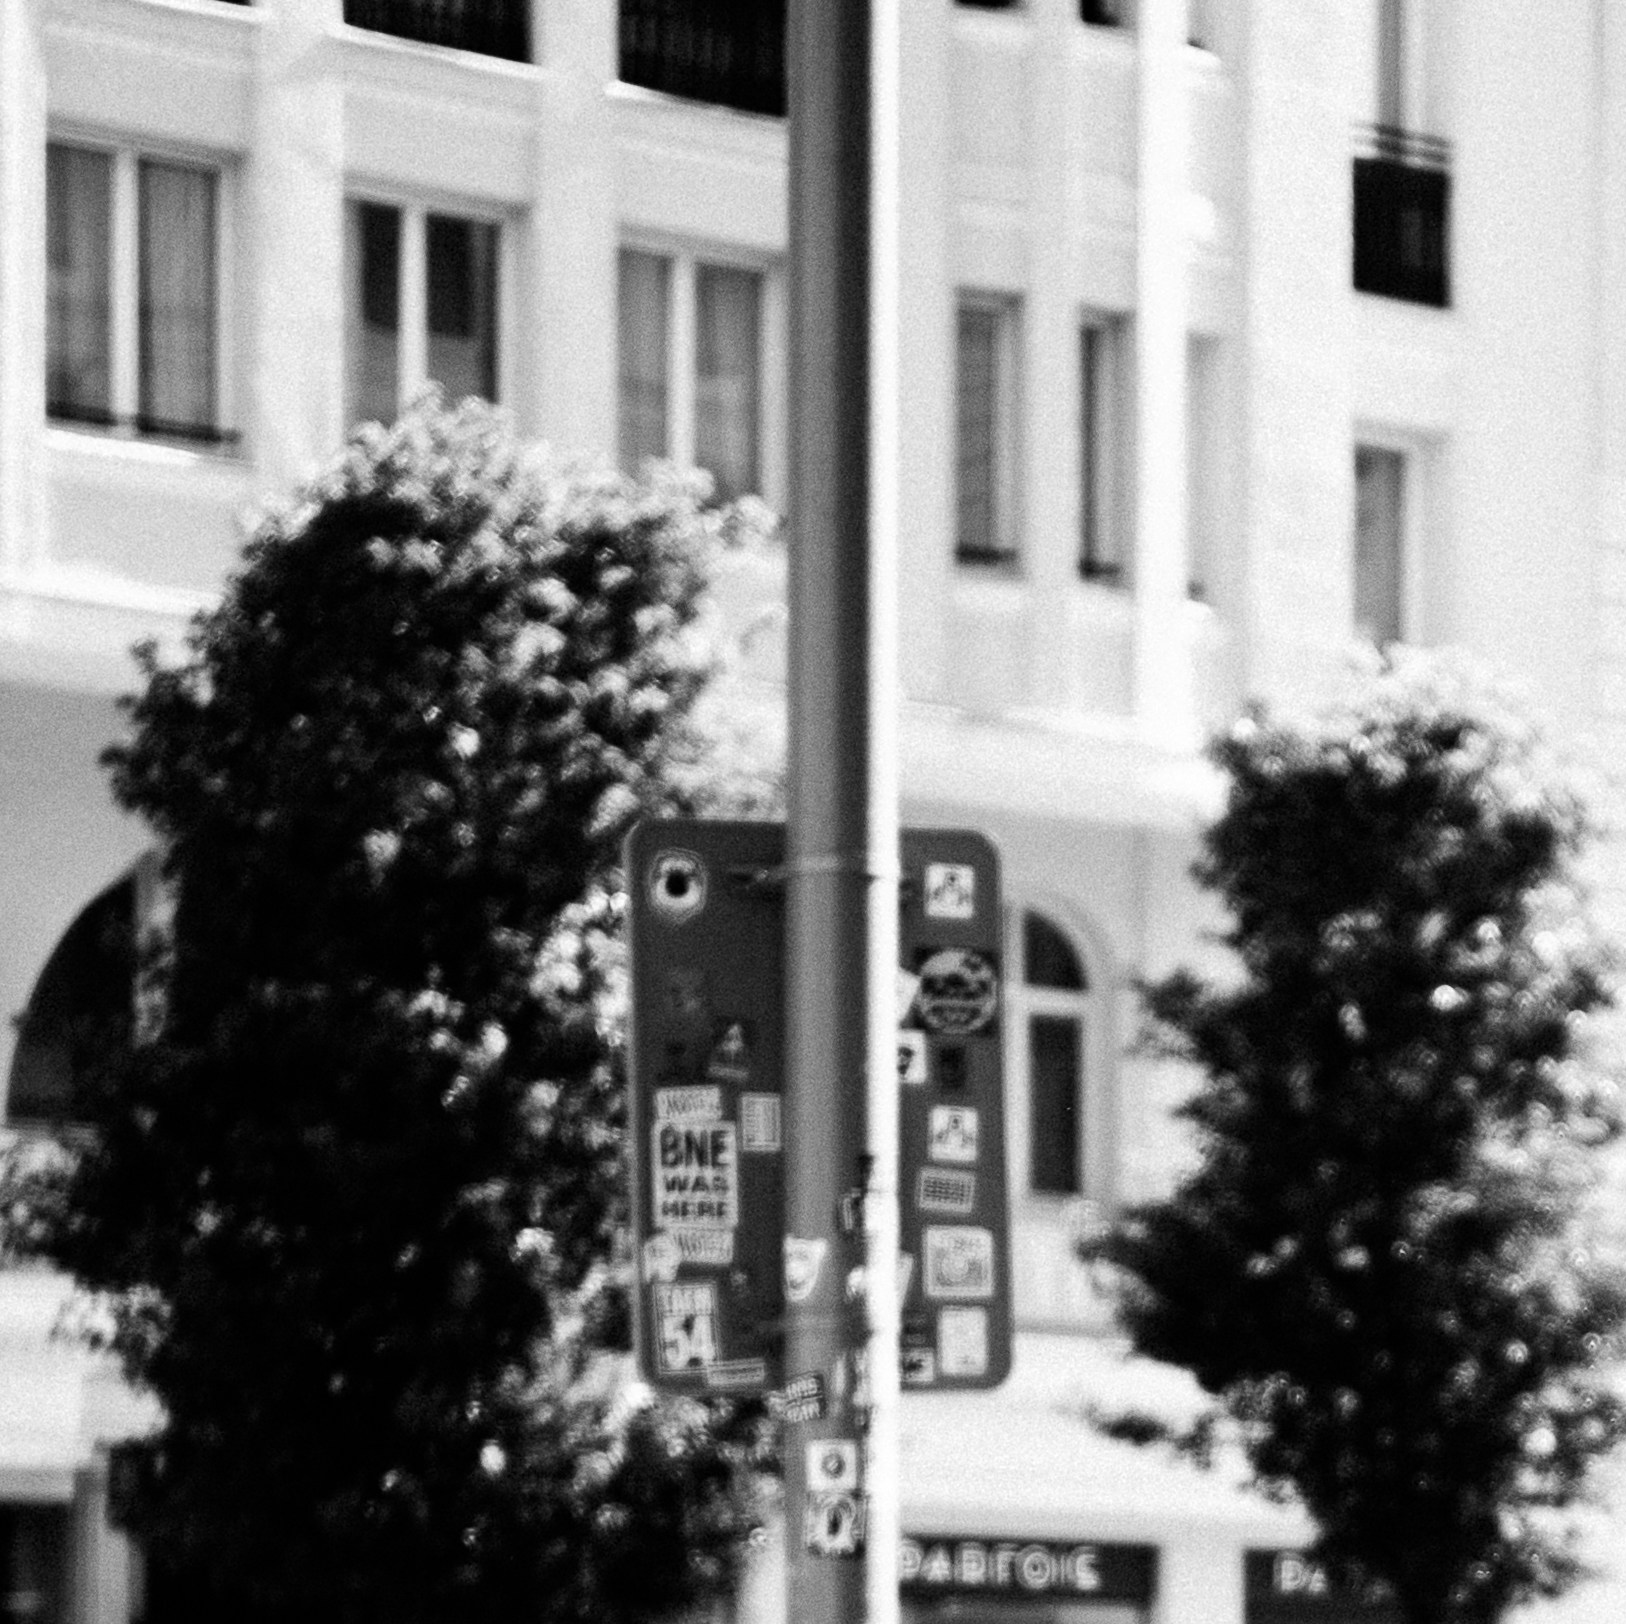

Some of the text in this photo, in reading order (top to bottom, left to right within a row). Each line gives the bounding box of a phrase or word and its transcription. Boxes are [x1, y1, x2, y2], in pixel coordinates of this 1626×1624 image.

[660, 1124, 730, 1168] BNE
[664, 1175, 730, 1193] WAS
[661, 1201, 728, 1218] HERE
